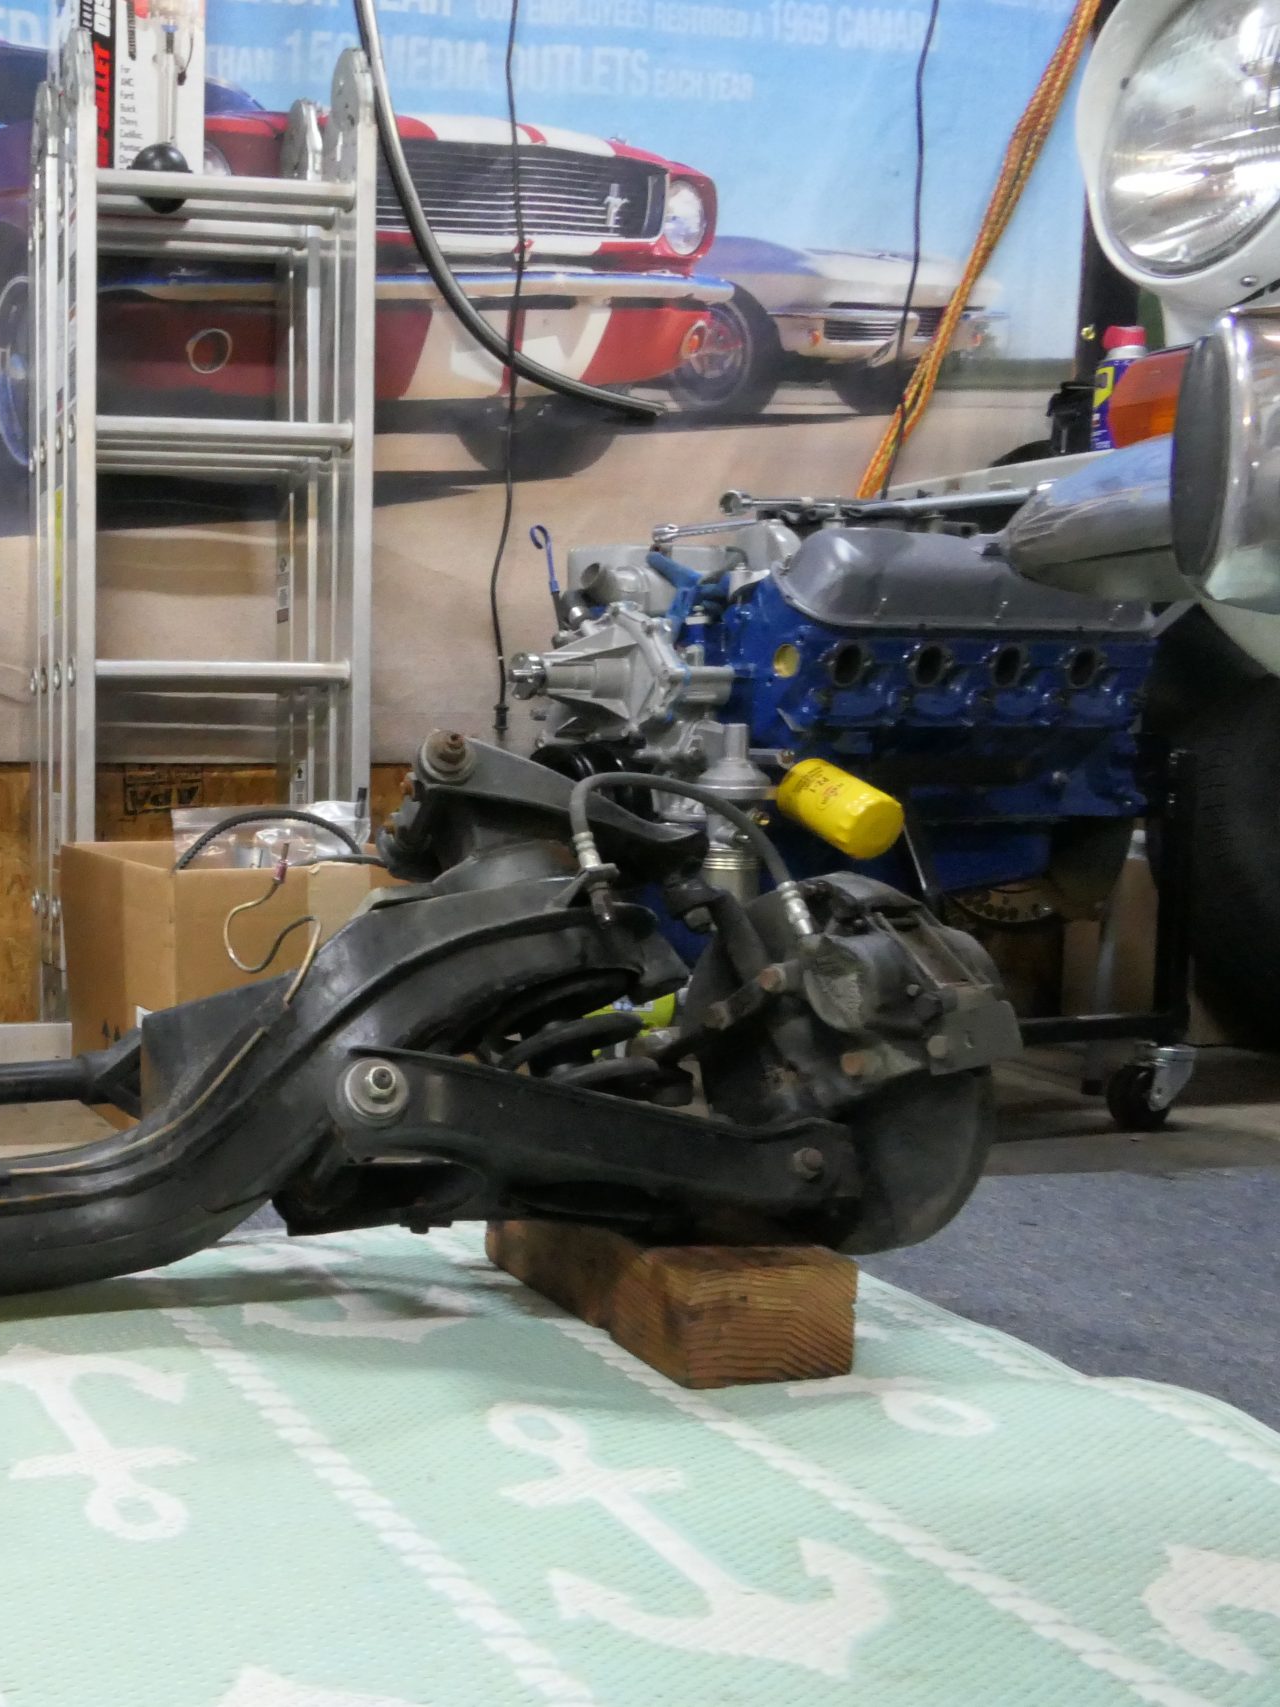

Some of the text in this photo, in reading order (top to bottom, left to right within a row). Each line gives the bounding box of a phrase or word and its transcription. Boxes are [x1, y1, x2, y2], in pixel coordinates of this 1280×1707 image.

[653, 2, 749, 38] RESTORED
[769, 0, 829, 46] 1969
[511, 43, 650, 97] OUTLETS
[654, 68, 704, 100] EACH
[709, 71, 754, 101] YEAR
